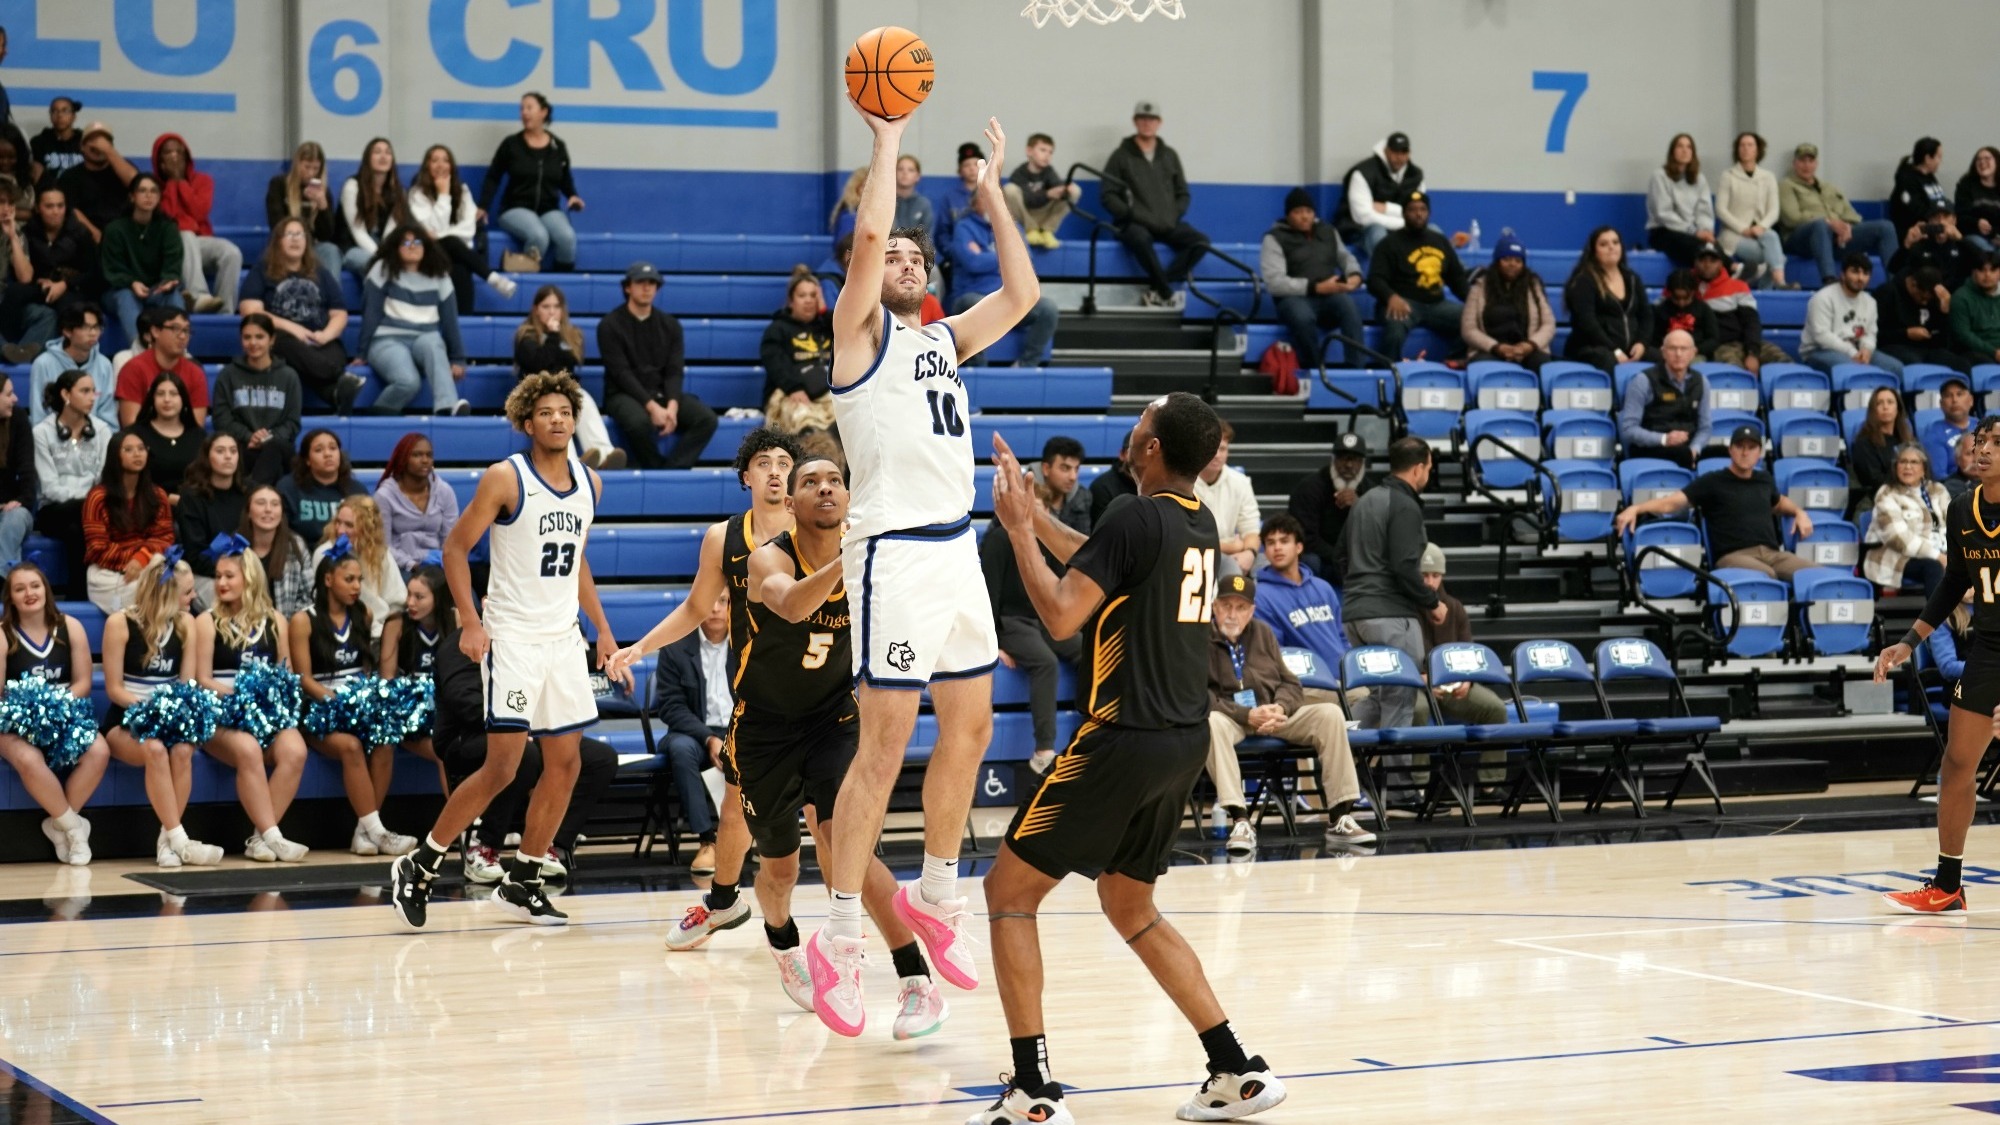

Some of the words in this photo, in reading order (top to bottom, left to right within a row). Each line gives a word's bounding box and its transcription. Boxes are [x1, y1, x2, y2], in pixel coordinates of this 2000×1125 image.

[428, 0, 778, 96] CRU
[307, 19, 383, 117] 6
[1531, 70, 1589, 153] 7
[914, 350, 962, 389] CSU
[926, 389, 965, 437] 10
[539, 511, 582, 537] CSUSM
[540, 542, 576, 577] 23
[1963, 546, 1981, 559] Los
[1177, 546, 1215, 623] 21
[149, 655, 173, 673] SM
[421, 652, 435, 667] S
[801, 631, 834, 670] 5
[31, 664, 62, 680] SM
